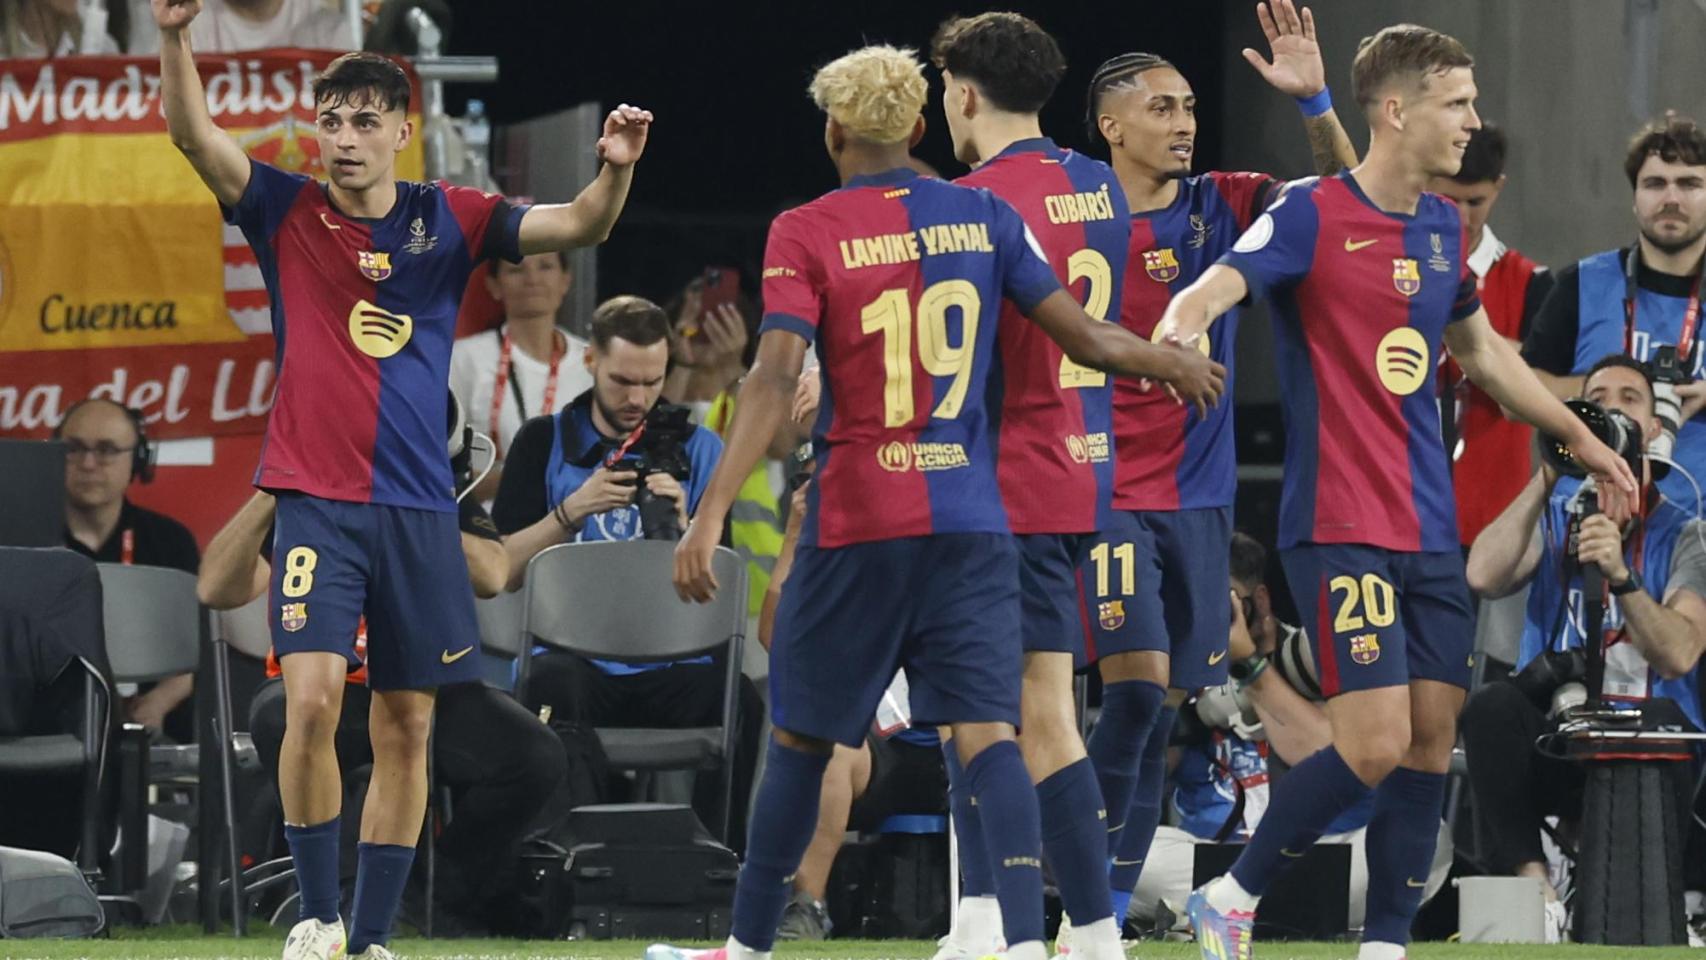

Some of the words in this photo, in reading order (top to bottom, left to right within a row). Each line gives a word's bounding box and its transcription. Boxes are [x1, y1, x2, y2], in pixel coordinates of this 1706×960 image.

[1045, 183, 1114, 224] CUBARSÍ
[840, 232, 921, 269] LAMINE
[919, 223, 994, 256] YAMAL
[40, 294, 178, 334] Cuenca
[1059, 248, 1112, 389] 2
[861, 279, 981, 428] 19
[88, 364, 190, 423] del
[912, 442, 965, 455] UNHCR
[915, 453, 969, 467] ACNUR
[282, 546, 318, 597] 8
[1090, 542, 1135, 597] 11
[1330, 573, 1395, 633] 20
